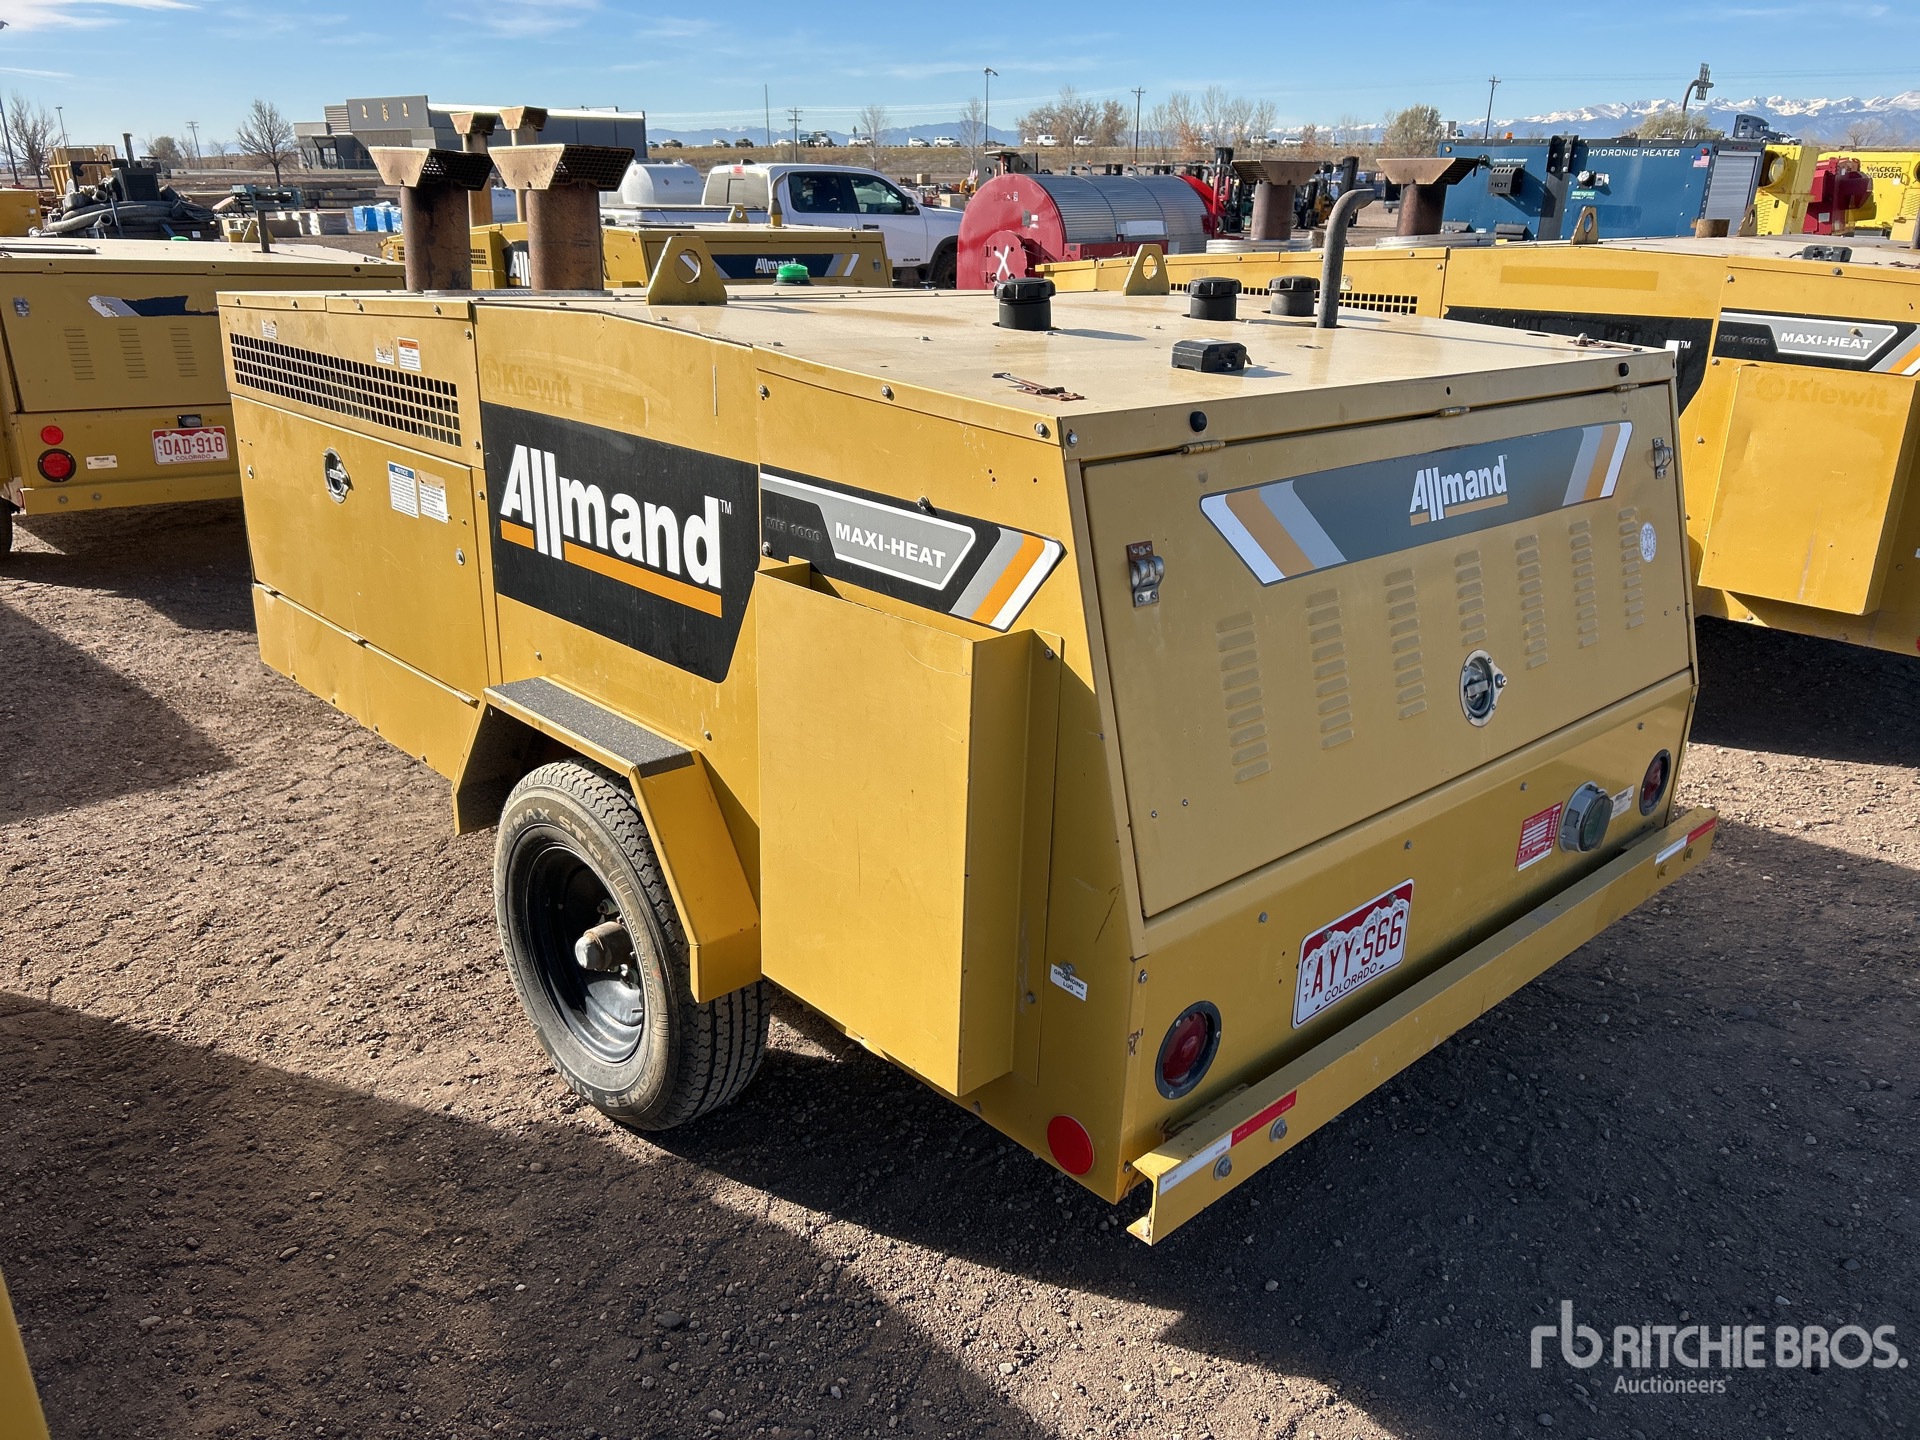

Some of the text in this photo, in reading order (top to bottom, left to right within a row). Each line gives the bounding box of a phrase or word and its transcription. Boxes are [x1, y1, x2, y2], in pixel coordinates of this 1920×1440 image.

[1588, 149, 1680, 157] HYDRONIC HEATER
[509, 251, 531, 286] All
[1781, 332, 1872, 350] MAXI-HEAT
[1409, 454, 1508, 522] Allmand
[500, 444, 722, 589] Allmand
[765, 516, 946, 569] MH 1000 MAXI-HEAT
[1053, 968, 1085, 990] GRONDING
[1062, 981, 1074, 991] LUG
[1324, 962, 1377, 1002] COLORADO
